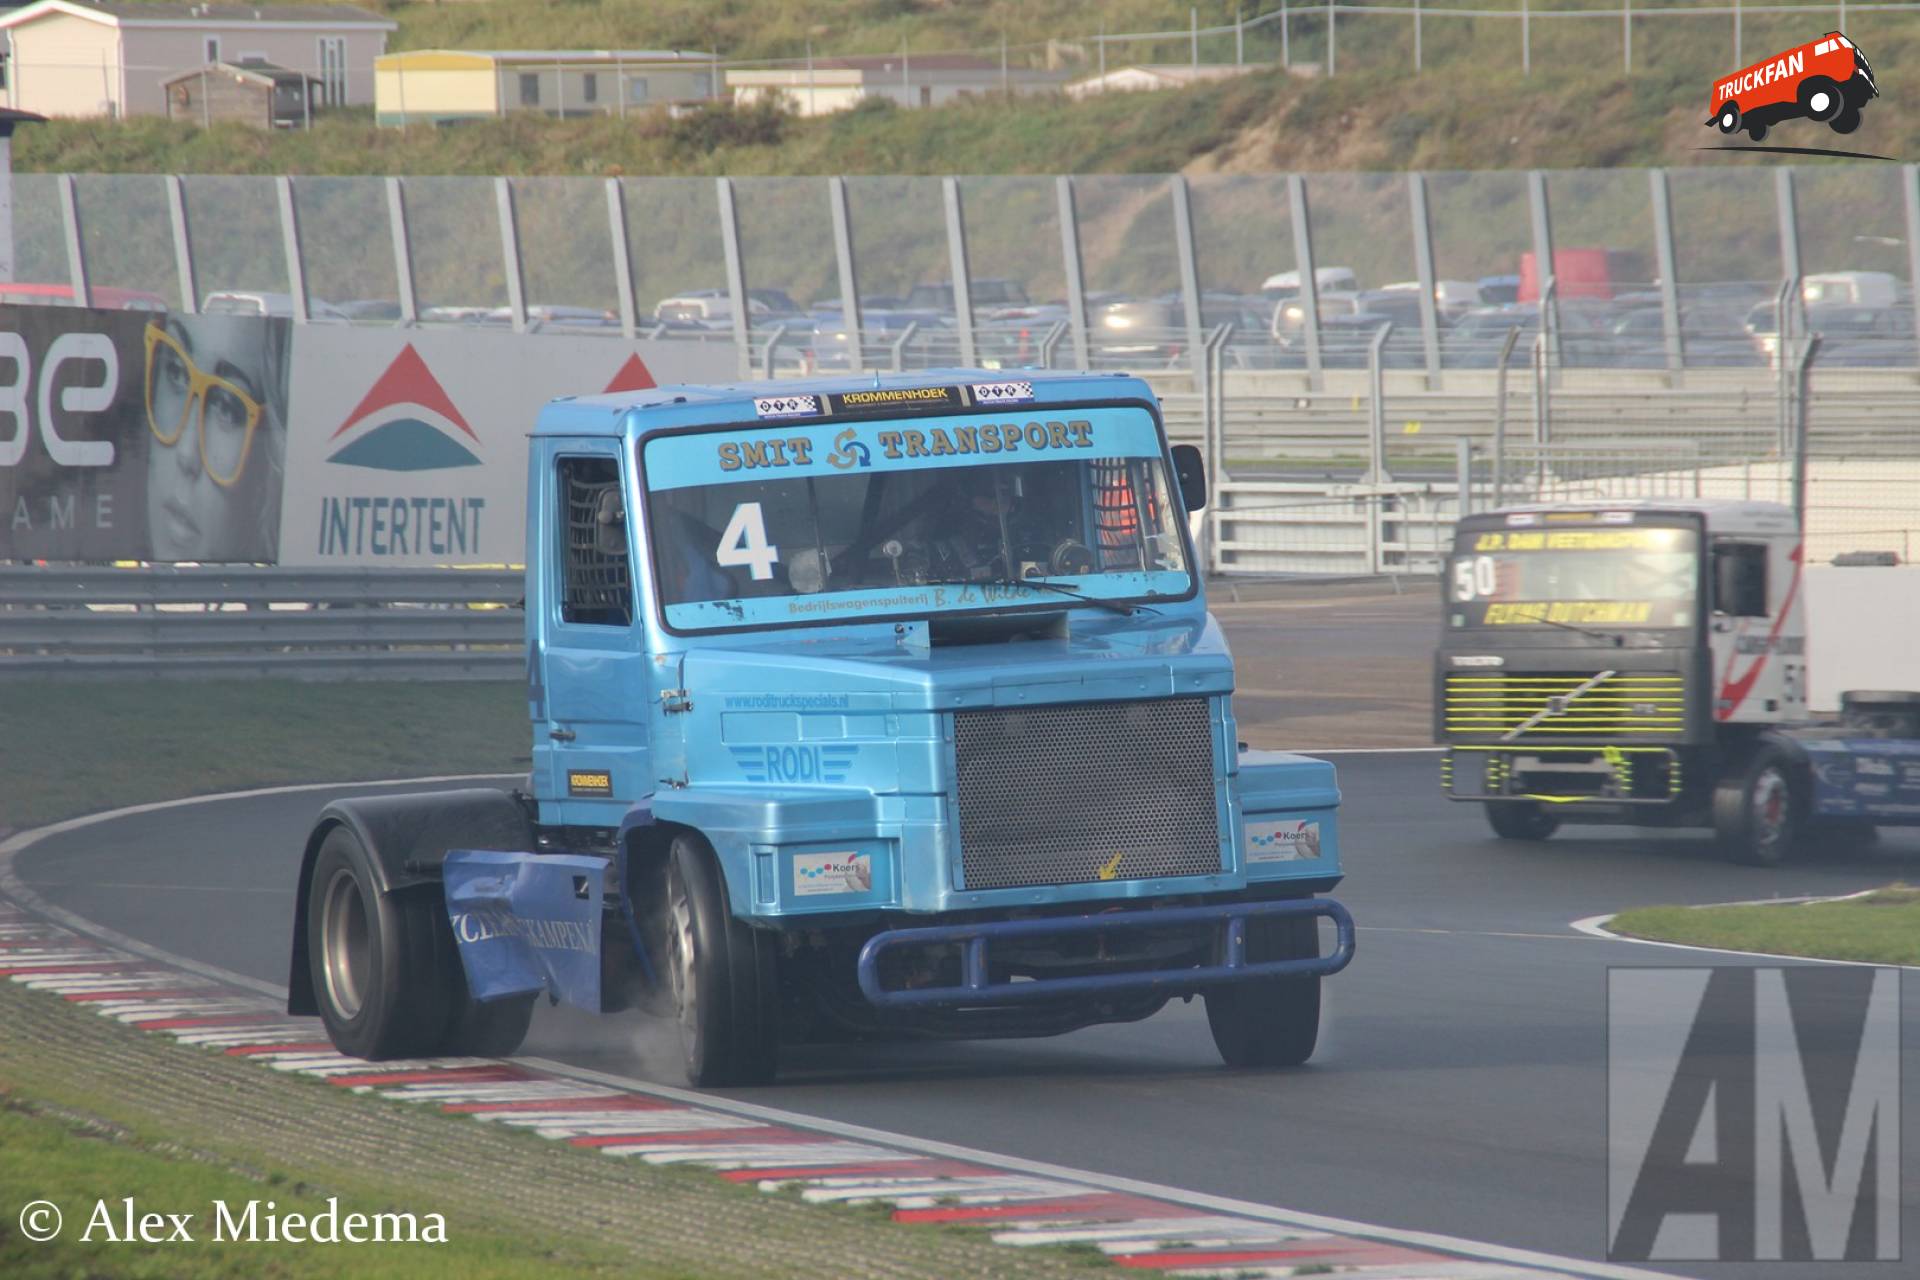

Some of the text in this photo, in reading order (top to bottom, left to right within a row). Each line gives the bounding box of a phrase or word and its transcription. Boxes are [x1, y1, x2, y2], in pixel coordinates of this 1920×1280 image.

[843, 387, 948, 404] KROMMENHOEK
[717, 419, 1095, 472] SMIT TRANSPORT
[318, 496, 486, 556] INTERTENT
[715, 501, 780, 581] 4
[1455, 555, 1496, 601] 50
[766, 745, 822, 783] RODI
